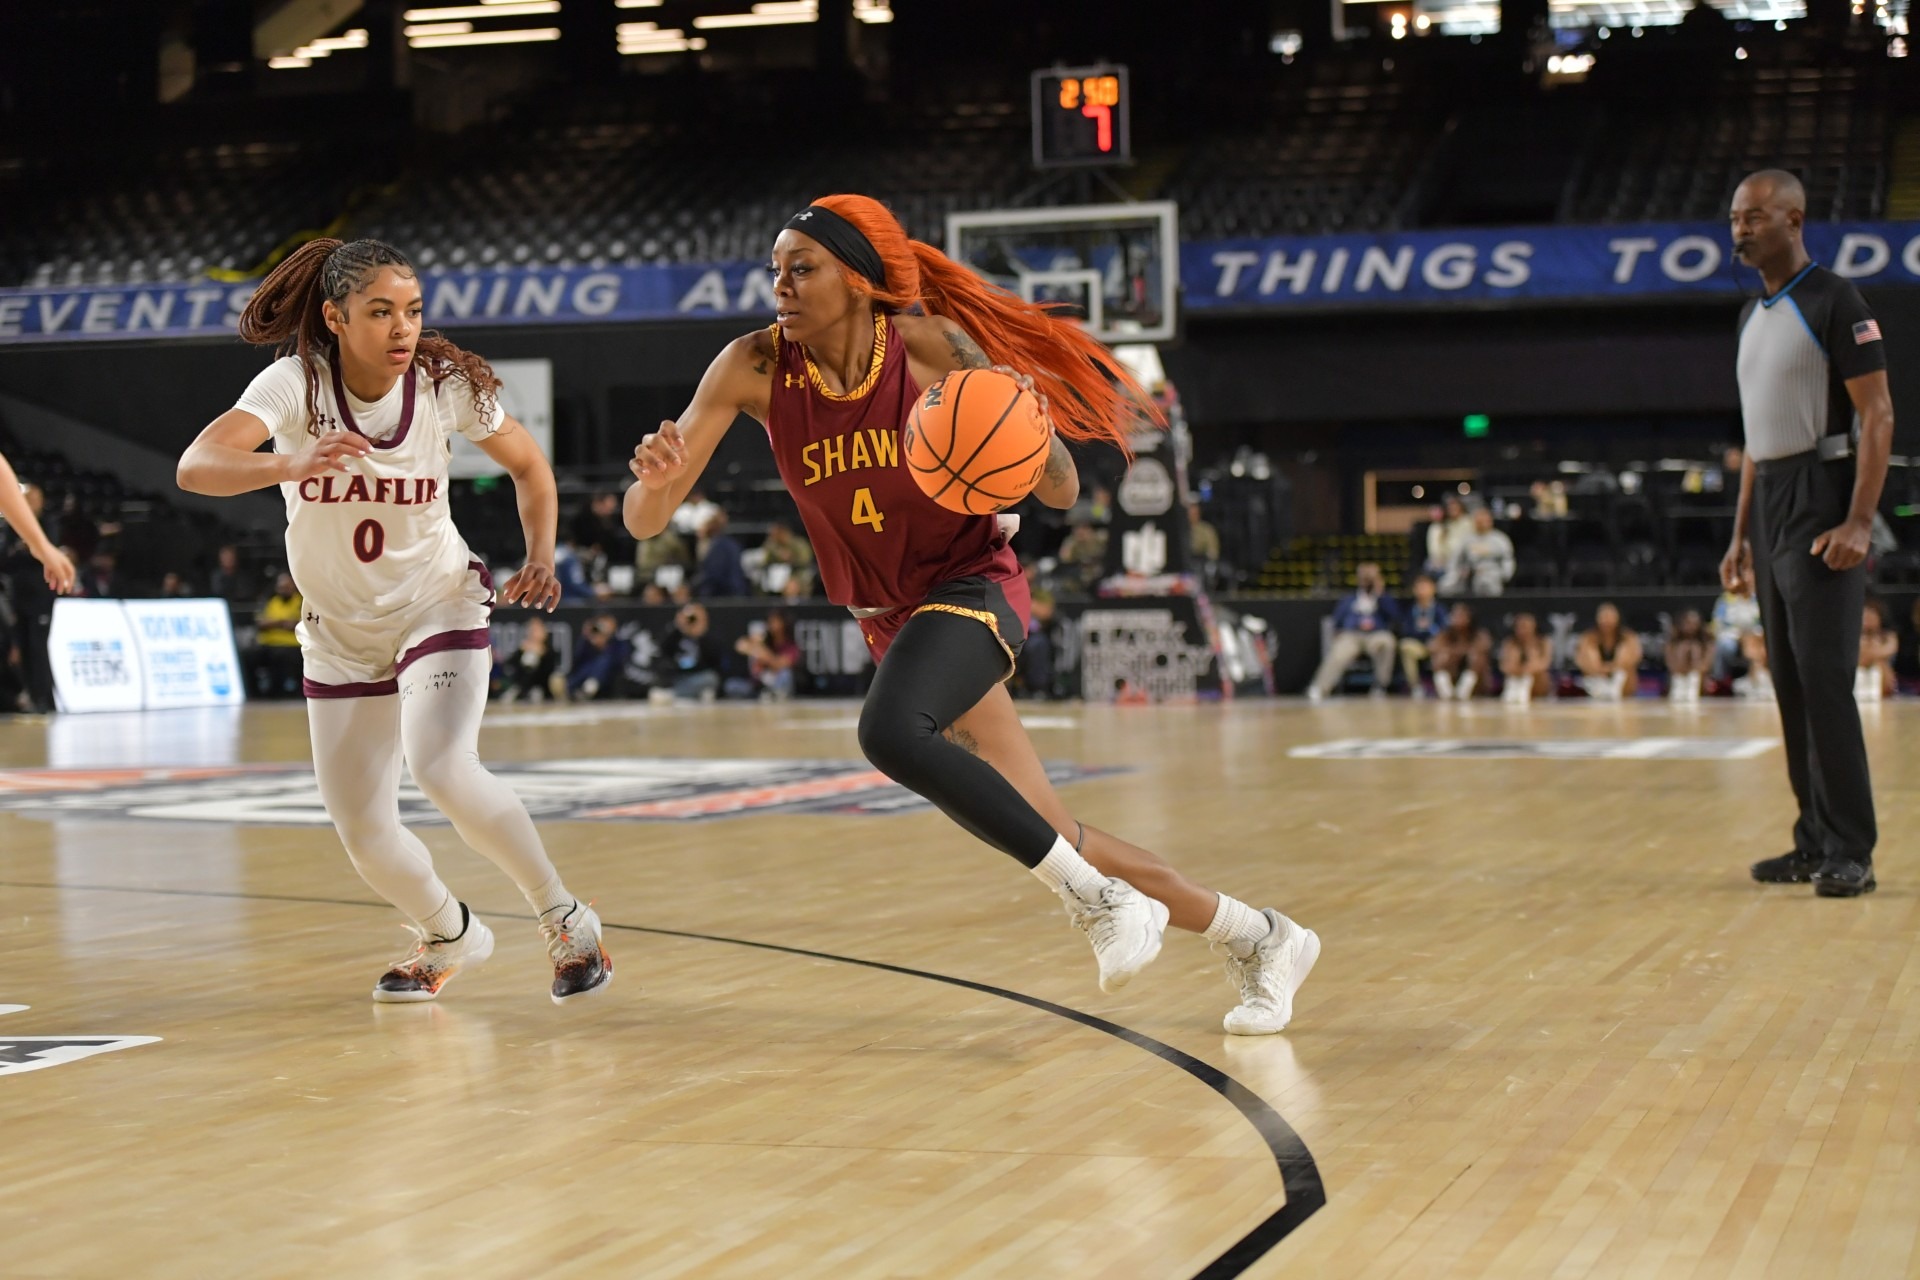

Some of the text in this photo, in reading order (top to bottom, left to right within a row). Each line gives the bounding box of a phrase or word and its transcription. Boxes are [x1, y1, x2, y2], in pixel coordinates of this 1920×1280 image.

[1082, 104, 1112, 151] 7
[428, 273, 622, 320] NING
[678, 269, 777, 313] AN
[1211, 241, 1534, 297] THINGS
[1609, 235, 1722, 283] TO
[802, 428, 899, 487] SHAW
[851, 487, 885, 533] 4
[353, 518, 385, 563] 0
